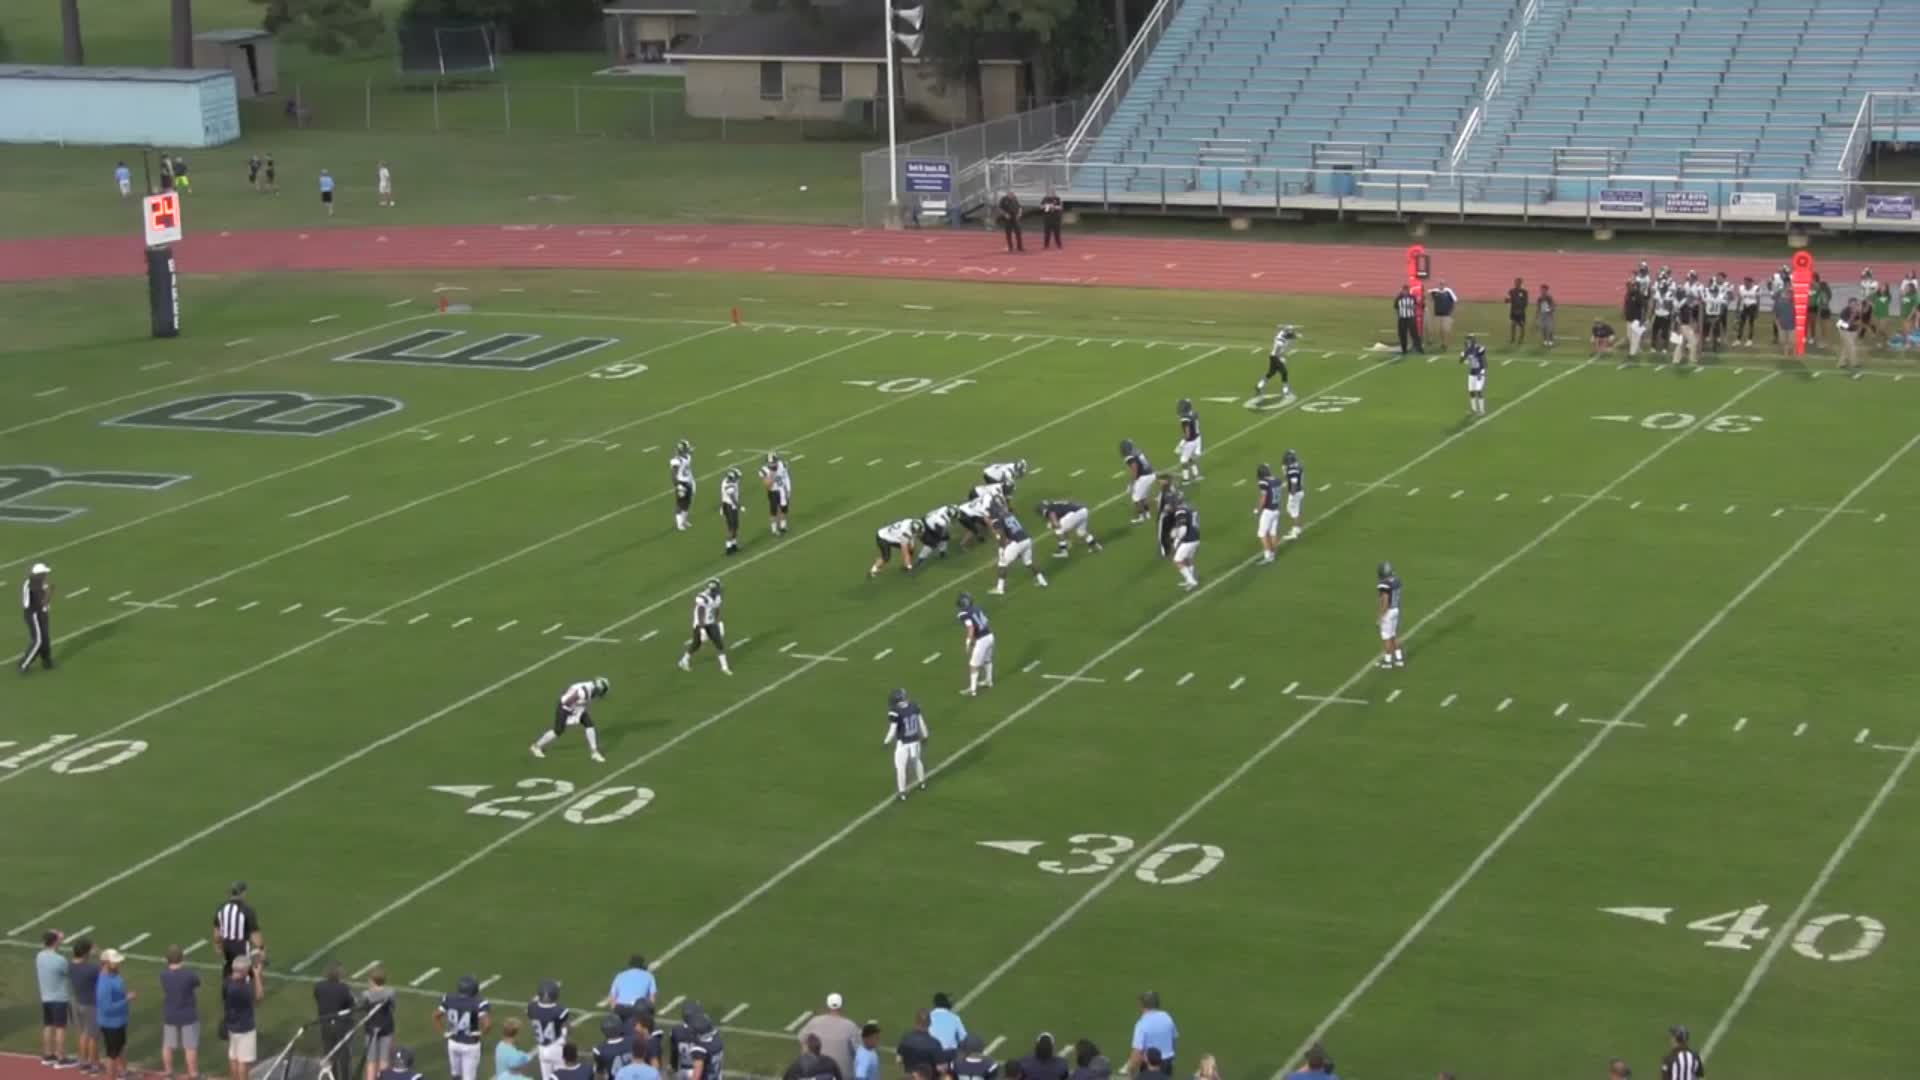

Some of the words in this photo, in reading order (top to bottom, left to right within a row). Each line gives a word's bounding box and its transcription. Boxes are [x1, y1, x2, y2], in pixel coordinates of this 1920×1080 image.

[150, 196, 180, 231] 24
[876, 377, 976, 394] 10
[1242, 393, 1361, 412] 20
[1640, 412, 1764, 432] 30
[466, 778, 655, 824] 20
[1037, 833, 1224, 884] 30
[1686, 903, 1885, 961] 40
